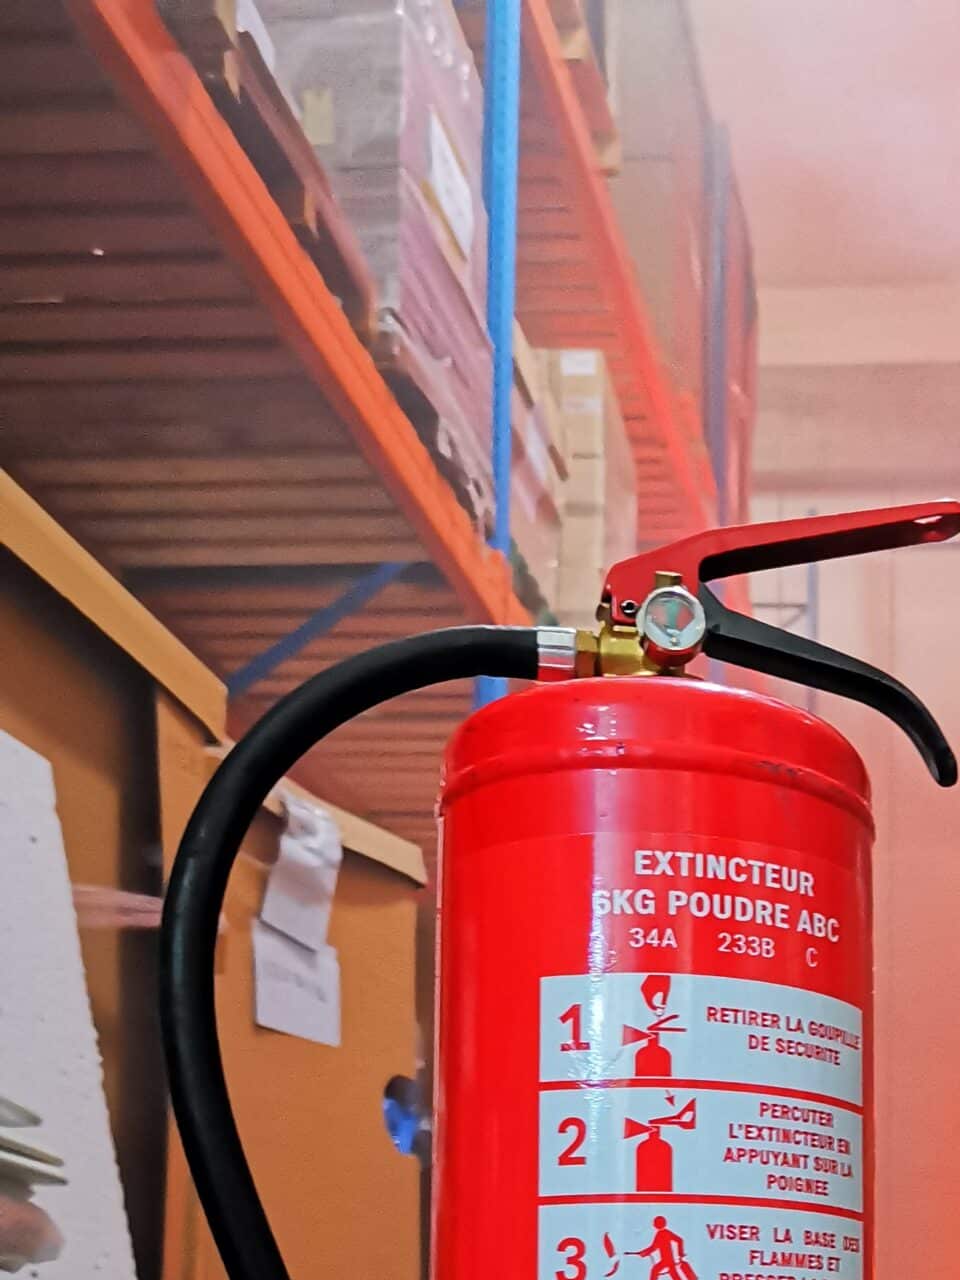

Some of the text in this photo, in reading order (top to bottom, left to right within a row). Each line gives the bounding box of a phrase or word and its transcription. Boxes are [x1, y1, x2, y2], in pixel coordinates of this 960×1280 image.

[634, 850, 815, 897] EXTINCTEUR
[593, 889, 840, 943] 6KG POUDRE ABC
[628, 927, 818, 968] 34A 233B C
[558, 1003, 591, 1052] 1
[706, 1006, 781, 1030] RETIRER
[785, 1015, 805, 1034] LA
[748, 1034, 770, 1051] DE
[759, 1102, 834, 1128] PERCUTER
[557, 1116, 587, 1166] 2
[728, 1123, 835, 1151] L'EXTINCTEUR
[723, 1147, 854, 1178] APPUYANT SUR LA
[706, 1223, 760, 1242] VISER
[773, 1227, 793, 1244] LA
[804, 1230, 836, 1249] BASE
[749, 1250, 841, 1272] FLAMMES ET
